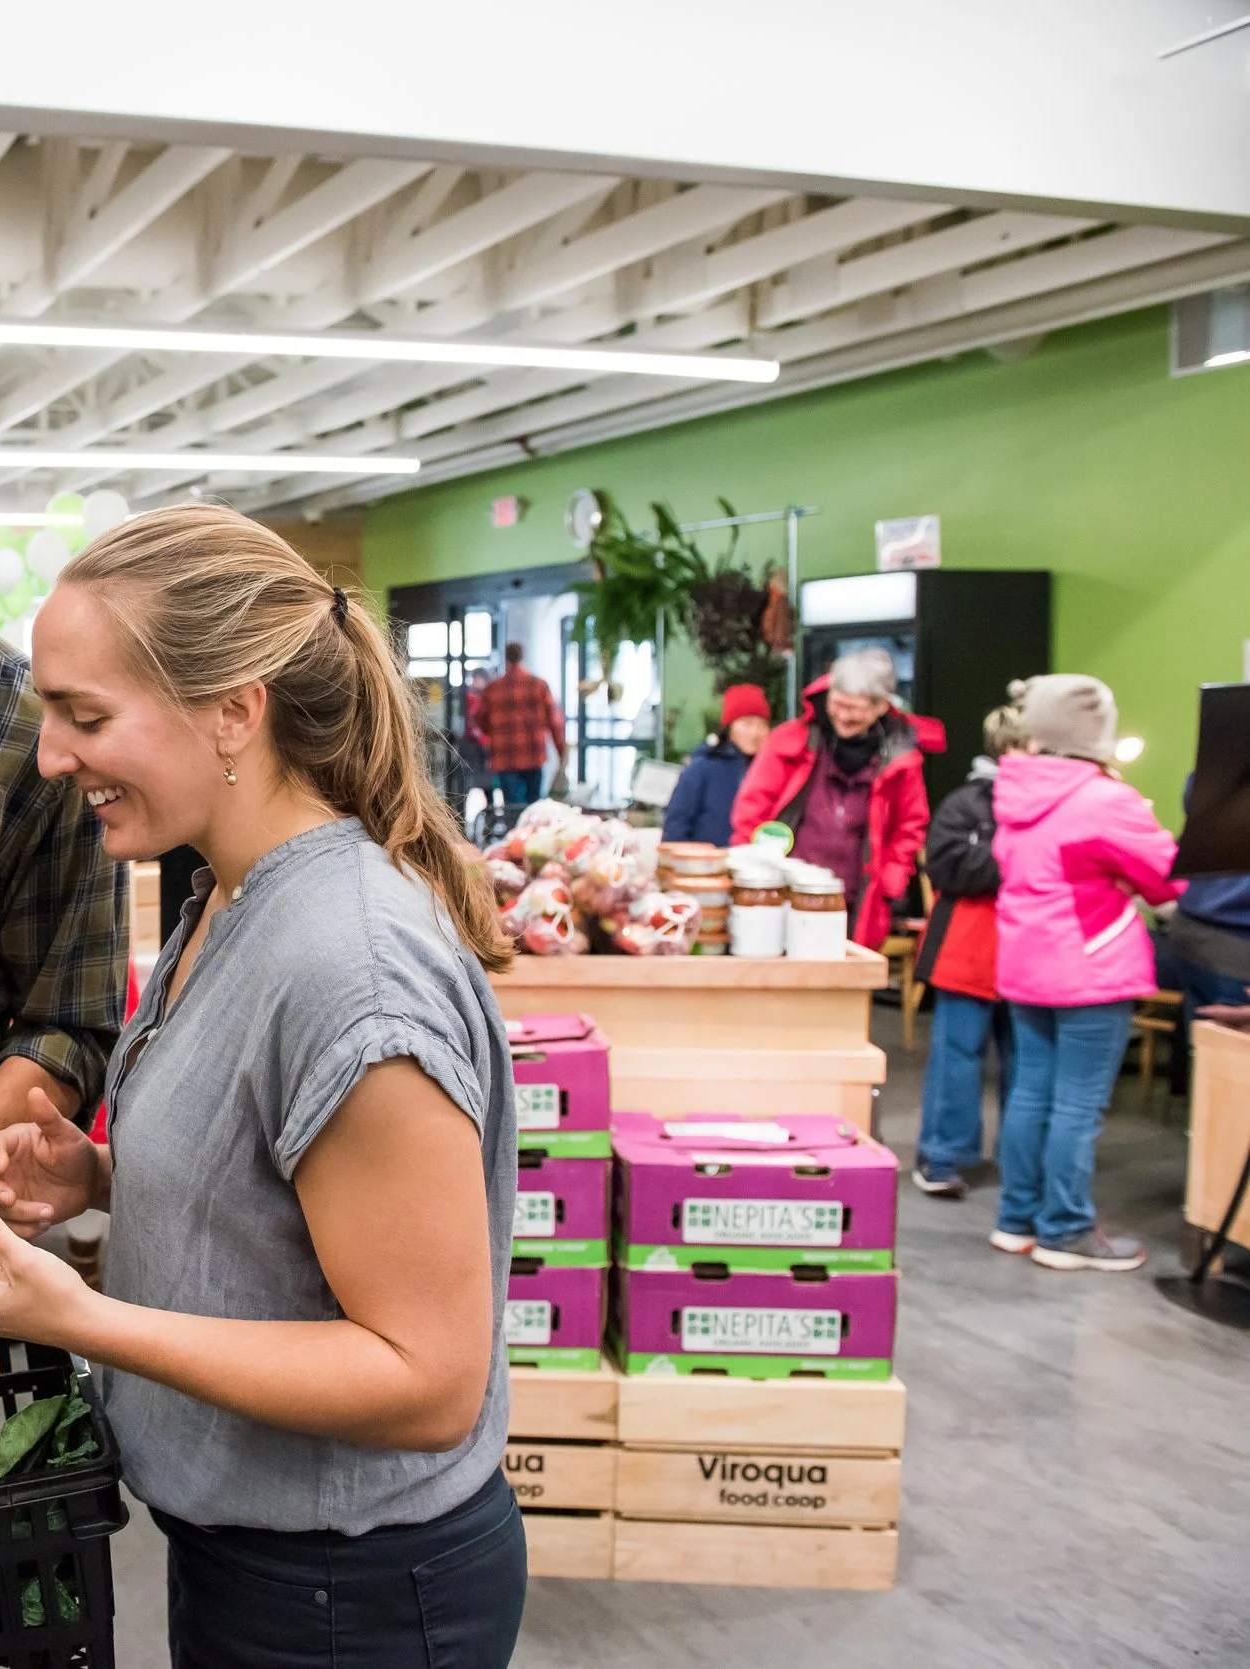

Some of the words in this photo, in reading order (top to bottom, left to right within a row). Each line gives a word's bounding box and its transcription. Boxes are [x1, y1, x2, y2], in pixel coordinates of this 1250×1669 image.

[714, 1204, 815, 1230] NEPITA'S
[713, 1312, 813, 1338] NEPITA'S
[698, 1454, 828, 1490] Viroqua
[719, 1488, 769, 1507] food
[772, 1493, 827, 1510] coop
